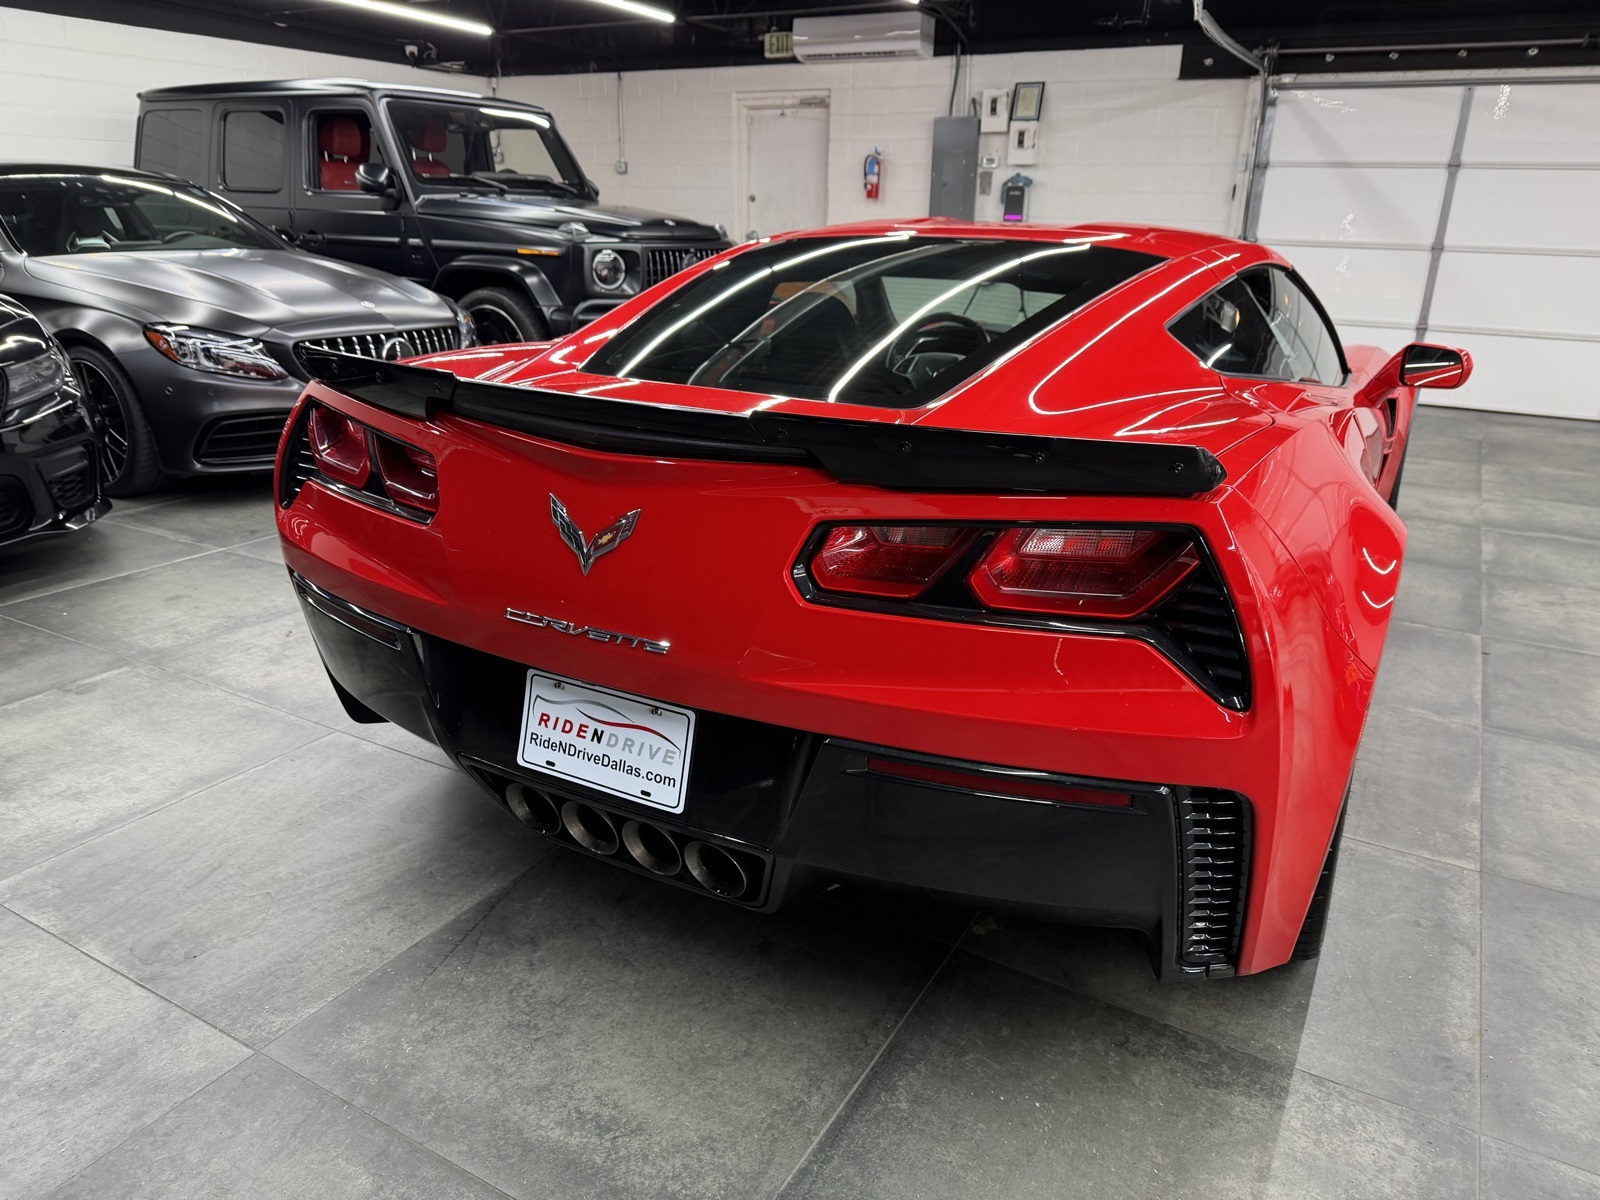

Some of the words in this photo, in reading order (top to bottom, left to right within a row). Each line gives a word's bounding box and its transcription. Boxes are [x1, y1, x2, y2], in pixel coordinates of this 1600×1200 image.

[769, 33, 790, 54] EXIT
[504, 607, 671, 655] CORVETTE
[529, 732, 676, 788] RideNDriveDallas.com
[537, 712, 677, 766] RIDENDRIVE
